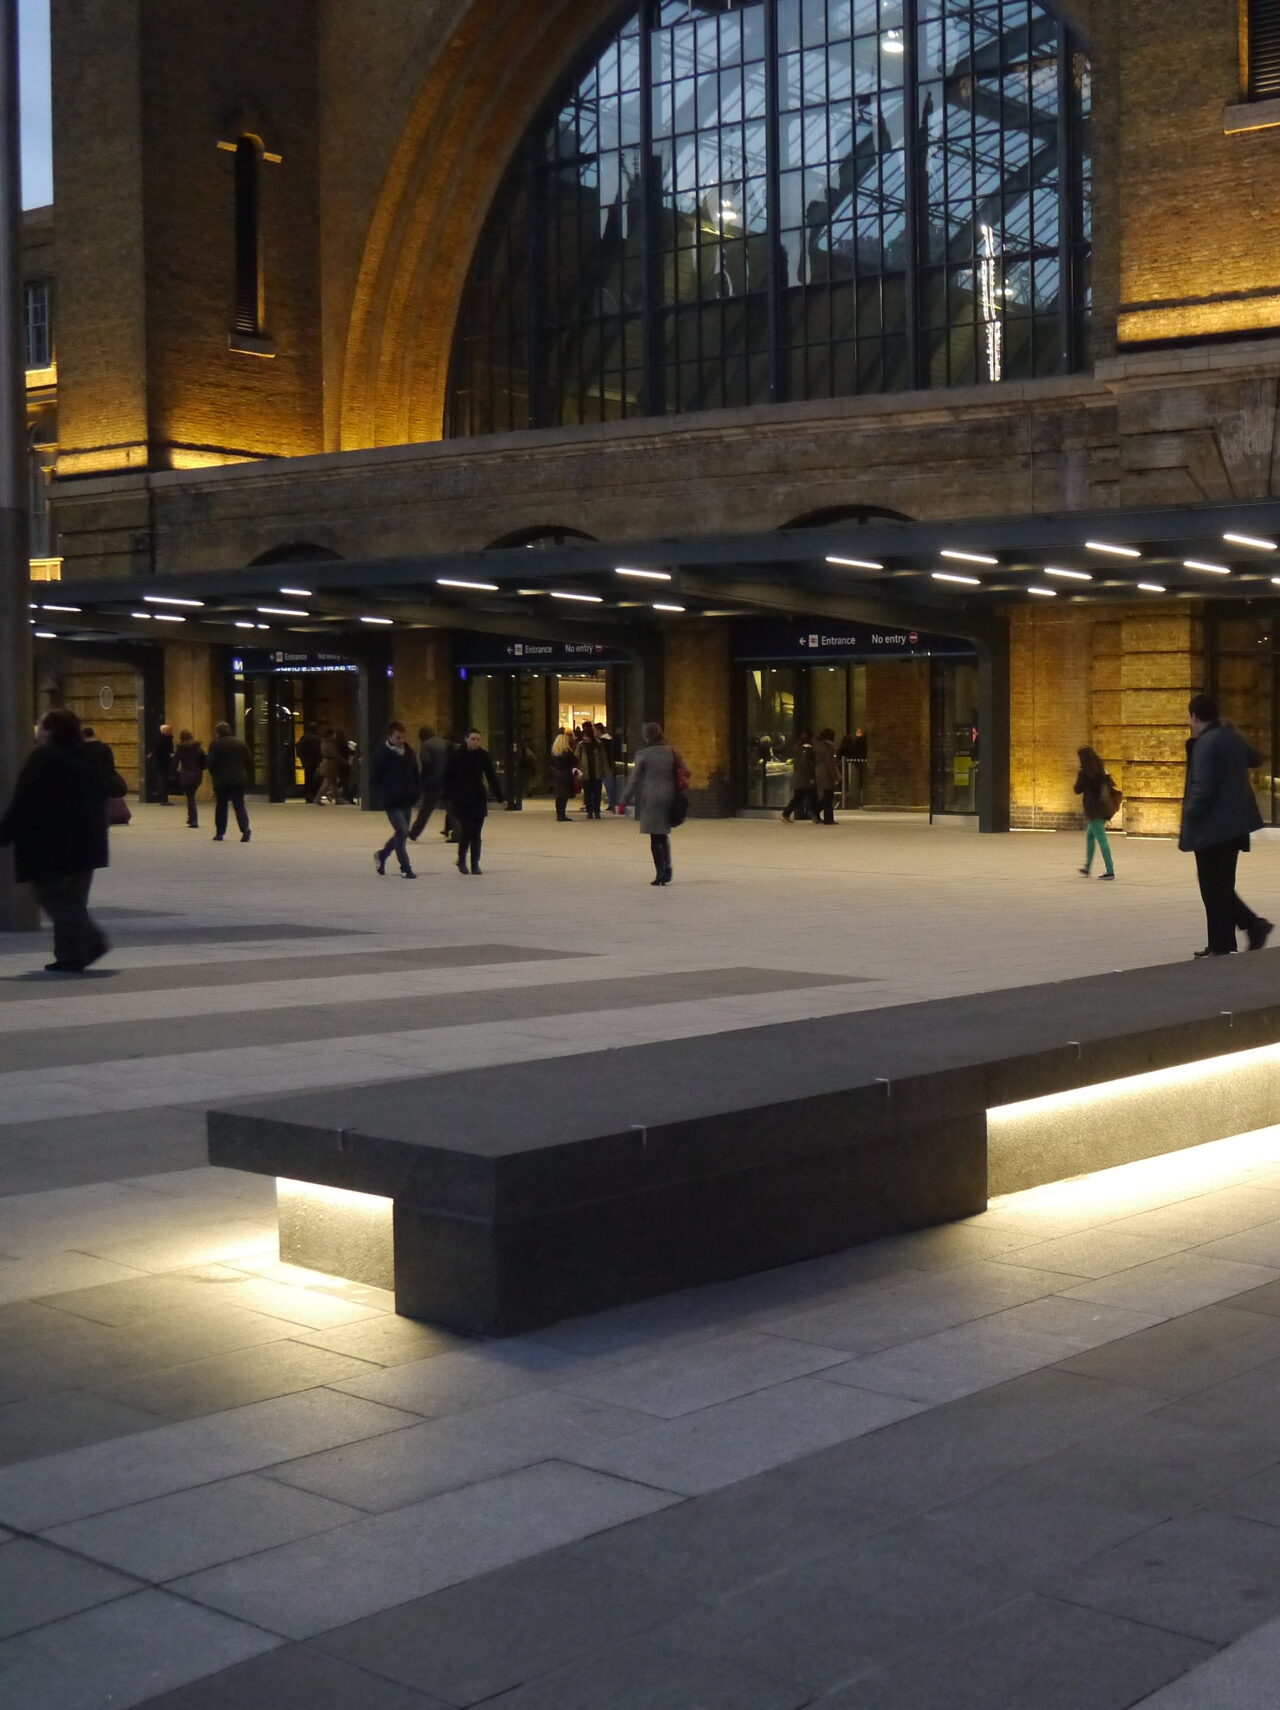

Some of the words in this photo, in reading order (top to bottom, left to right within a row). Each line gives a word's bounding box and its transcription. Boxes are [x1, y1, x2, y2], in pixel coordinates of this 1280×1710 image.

[821, 636, 856, 645] Entrance
[872, 634, 882, 644] No
[885, 635, 906, 645] entry
[525, 645, 552, 653] Entrance
[565, 644, 575, 653] No
[576, 644, 593, 653] entry
